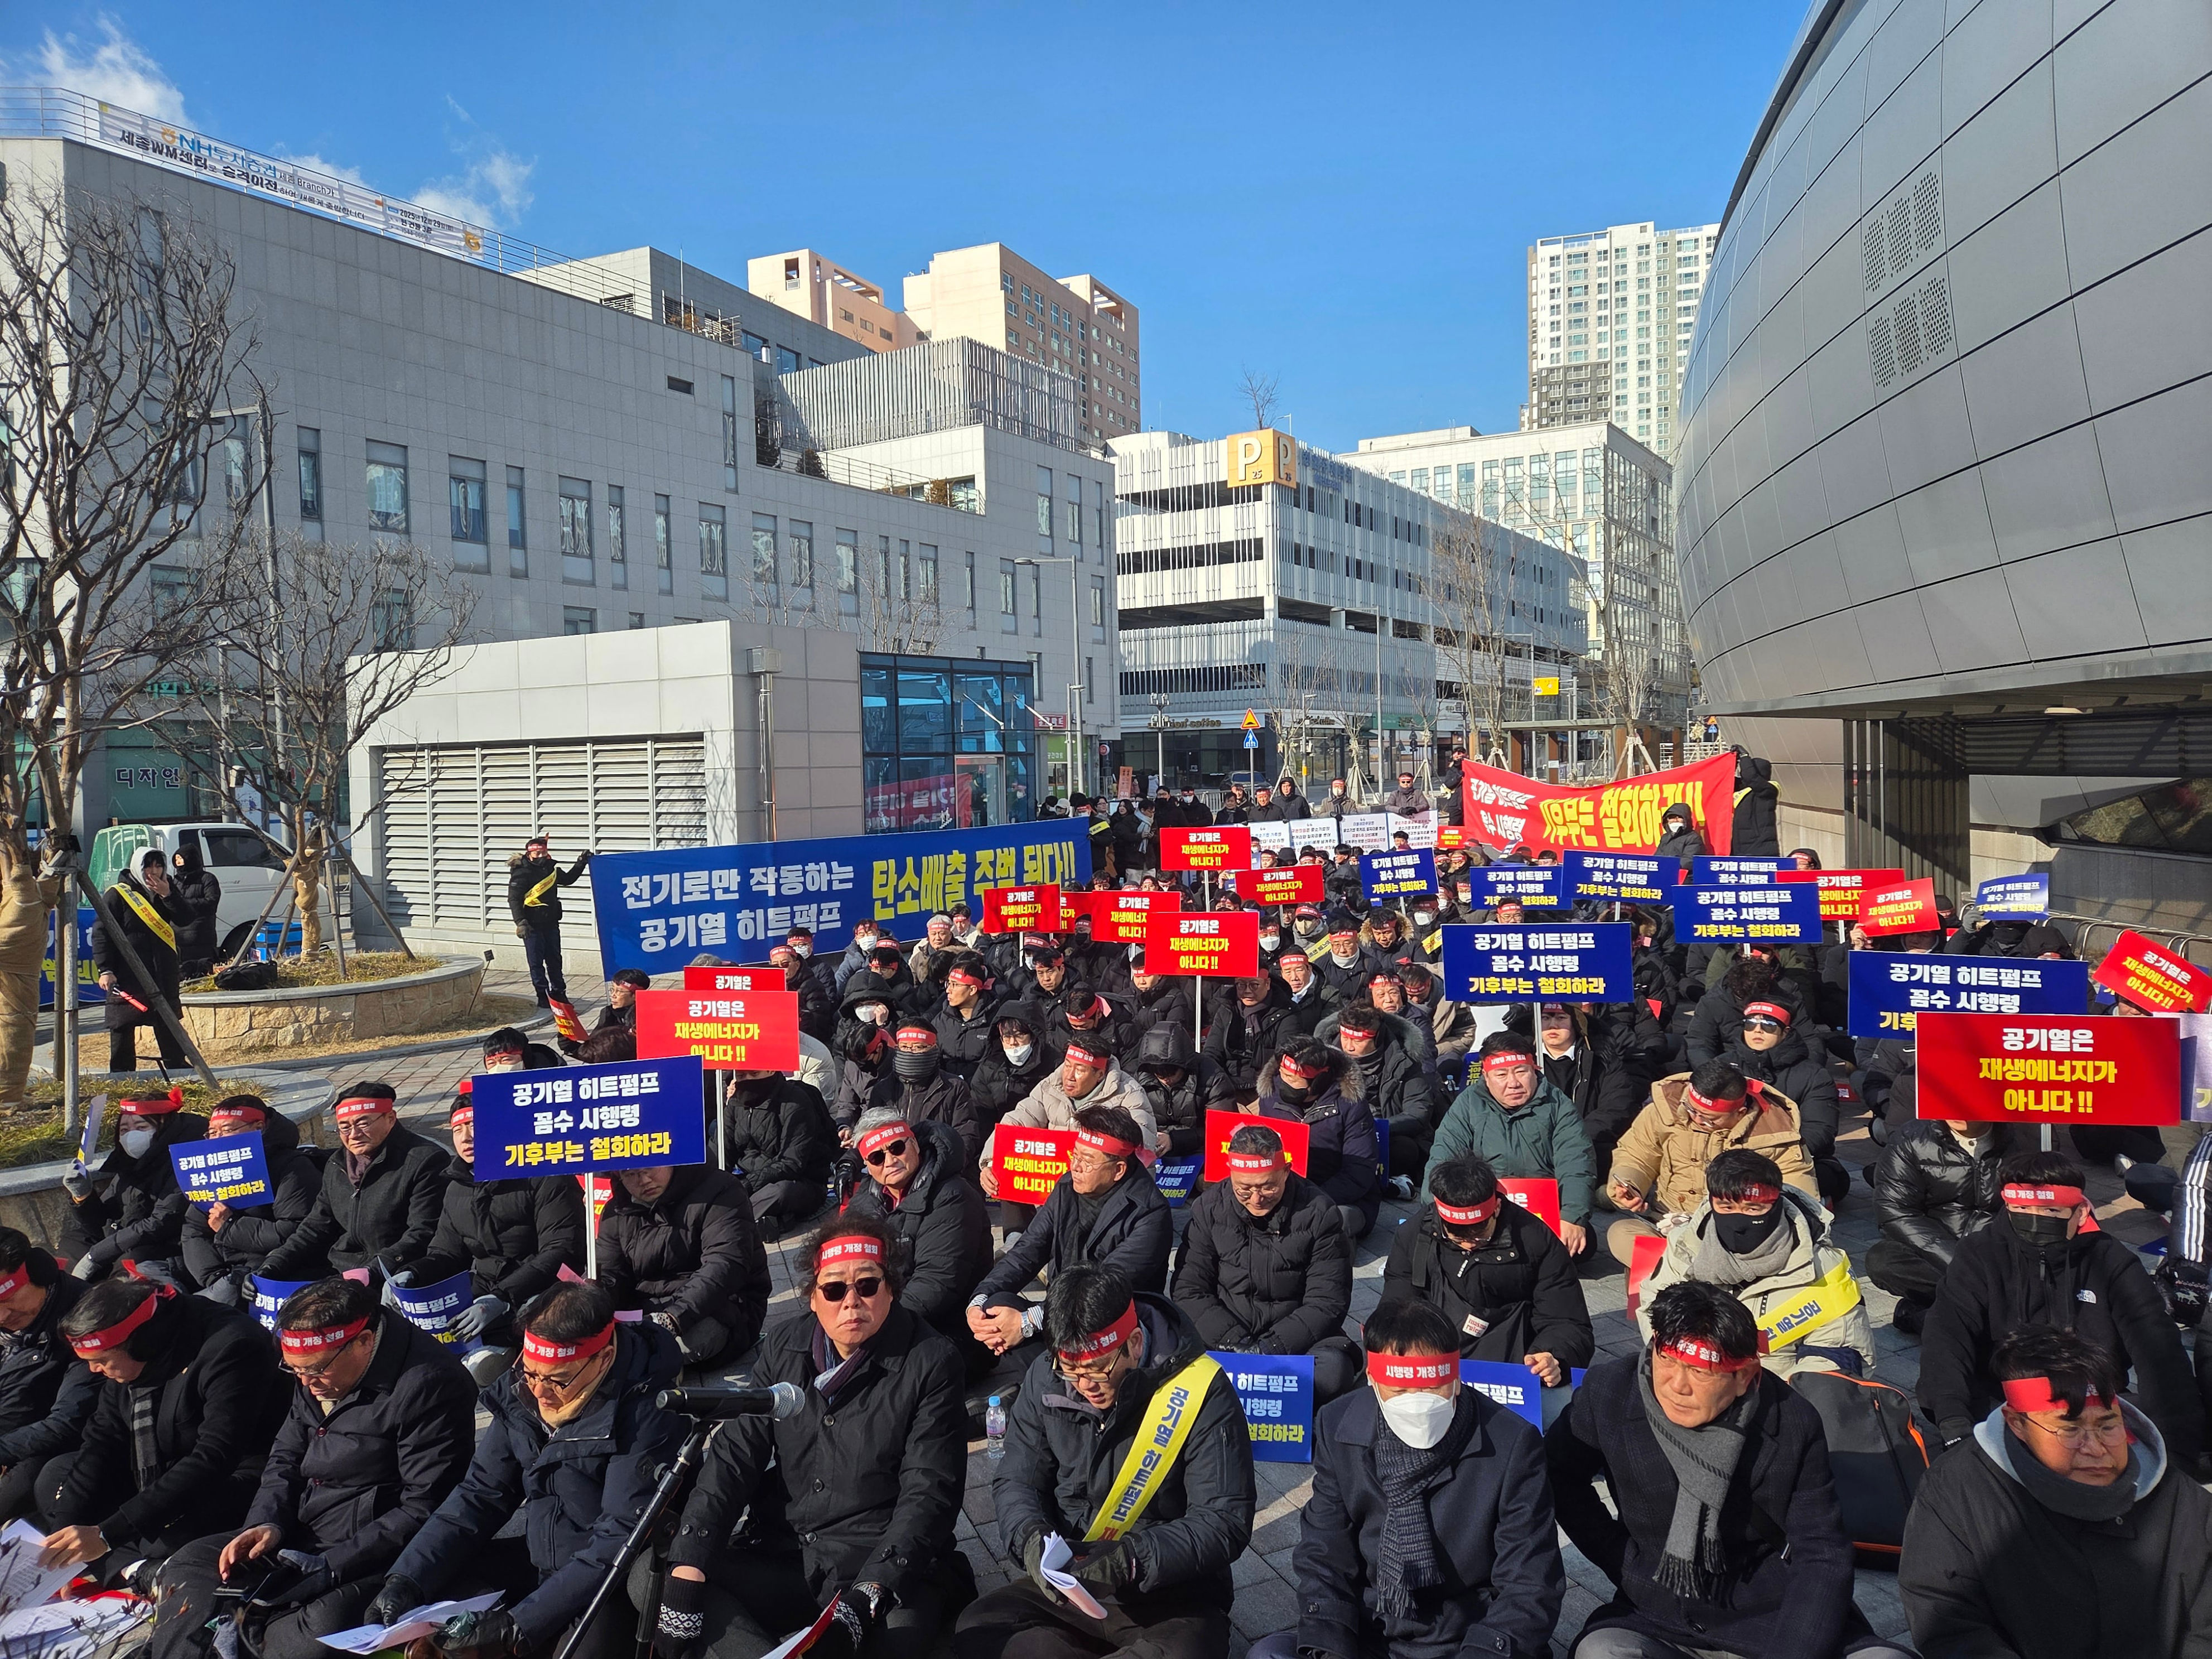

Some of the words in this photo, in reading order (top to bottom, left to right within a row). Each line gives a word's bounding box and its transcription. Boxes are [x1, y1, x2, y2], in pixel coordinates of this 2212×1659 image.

[180, 133, 277, 179] NH투자증권
[297, 177, 335, 197] Branch가
[1237, 437, 1263, 481] P
[1278, 436, 1292, 480] P
[1252, 470, 1263, 480] 25
[115, 767, 180, 789] 디자인
[1189, 833, 1221, 842] 공기열은
[1583, 857, 1614, 869] 공기열
[1617, 859, 1658, 871] 히트펌프
[1263, 871, 1294, 881] 공기열은
[1487, 872, 1514, 881] 공기열
[1516, 871, 1552, 880] 히트펌프
[1593, 871, 1613, 882] 꼼수
[1616, 873, 1647, 885] 시행령
[622, 869, 740, 909] 전기로만
[750, 861, 854, 896] 작동하는
[872, 848, 967, 922] 탄소배출
[1496, 884, 1515, 893] 꼼수
[1517, 884, 1544, 893] 시행령
[1577, 884, 1617, 896] 기후부는
[1620, 886, 1662, 899] 철회하라
[1008, 891, 1034, 902] 공기열은
[1521, 896, 1558, 905] 철회하라
[1698, 891, 1736, 904] 공기열
[1738, 891, 1792, 903] 히트펌프
[1877, 890, 1912, 903] 공기열은
[1711, 908, 1737, 920] 꼼수
[1740, 908, 1780, 920] 시행령
[1868, 900, 1923, 915] 재생에너지가
[640, 913, 726, 952] 공기열
[736, 901, 841, 939] 히트펌프
[1180, 920, 1219, 933] 공기열은
[1694, 924, 1744, 937] 기후부는
[1747, 924, 1801, 937] 철회하라
[1170, 938, 1229, 951] 재생에너지가
[1474, 933, 1523, 950] 공기열
[1528, 933, 1595, 949] 히트펌프
[1492, 956, 1524, 972] 꼼수
[1529, 955, 1579, 972] 시행령
[2143, 950, 2191, 985] 공기열은
[716, 976, 751, 990] 공기열은
[1890, 963, 1950, 984] 공기열
[1957, 967, 2041, 987] 히트펌프
[2122, 956, 2193, 1004] 재생에너지가
[1469, 977, 1534, 994] 기후부는
[1538, 977, 1606, 994] 철회하라
[689, 1001, 744, 1017] 공기열은
[1910, 989, 1950, 1009] 꼼수
[1956, 992, 2021, 1015] 시행령
[1880, 1011, 1916, 1031] 기후
[675, 1023, 760, 1040] 재생에너지가
[2003, 1029, 2094, 1052] 공기열은
[1980, 1058, 2117, 1083] 재생에너지가
[513, 1080, 572, 1106] 공기열
[579, 1072, 659, 1099] 히트펌프
[534, 1110, 573, 1134] 꼼수
[580, 1104, 639, 1130] 시행령
[880, 1128, 893, 1138] 개정
[1091, 1135, 1104, 1146] 철회
[505, 1141, 584, 1166] 기후부는
[590, 1132, 671, 1160] 철회하라
[1015, 1140, 1056, 1156] 공기열은
[179, 1155, 205, 1170] 공기열
[206, 1147, 252, 1166] 히트펌프
[1004, 1157, 1068, 1175] 재생에너지가
[190, 1173, 208, 1186] 꼼수
[210, 1166, 243, 1183] 시행령
[216, 1180, 265, 1200] 철회하라
[2017, 1189, 2034, 1199] 개정
[2036, 1190, 2054, 1200] 철회
[1452, 1212, 1466, 1220] 개정
[1467, 1209, 1481, 1219] 철회
[844, 1243, 862, 1253] 개정
[864, 1244, 878, 1255] 철회
[255, 1293, 276, 1311] 공기열
[402, 1293, 459, 1314] 히트펌프
[1776, 1300, 1822, 1334] 공기열
[303, 1336, 322, 1347] 개정
[537, 1345, 555, 1358] 개정
[557, 1346, 575, 1357] 철회
[1386, 1365, 1414, 1379] 시행령
[1416, 1366, 1435, 1378] 개정
[1438, 1363, 1450, 1377] 철회
[1237, 1373, 1298, 1392] 히트펌프
[1153, 1386, 1189, 1448] 공기열
[1111, 1449, 1163, 1522] 히트펌프
